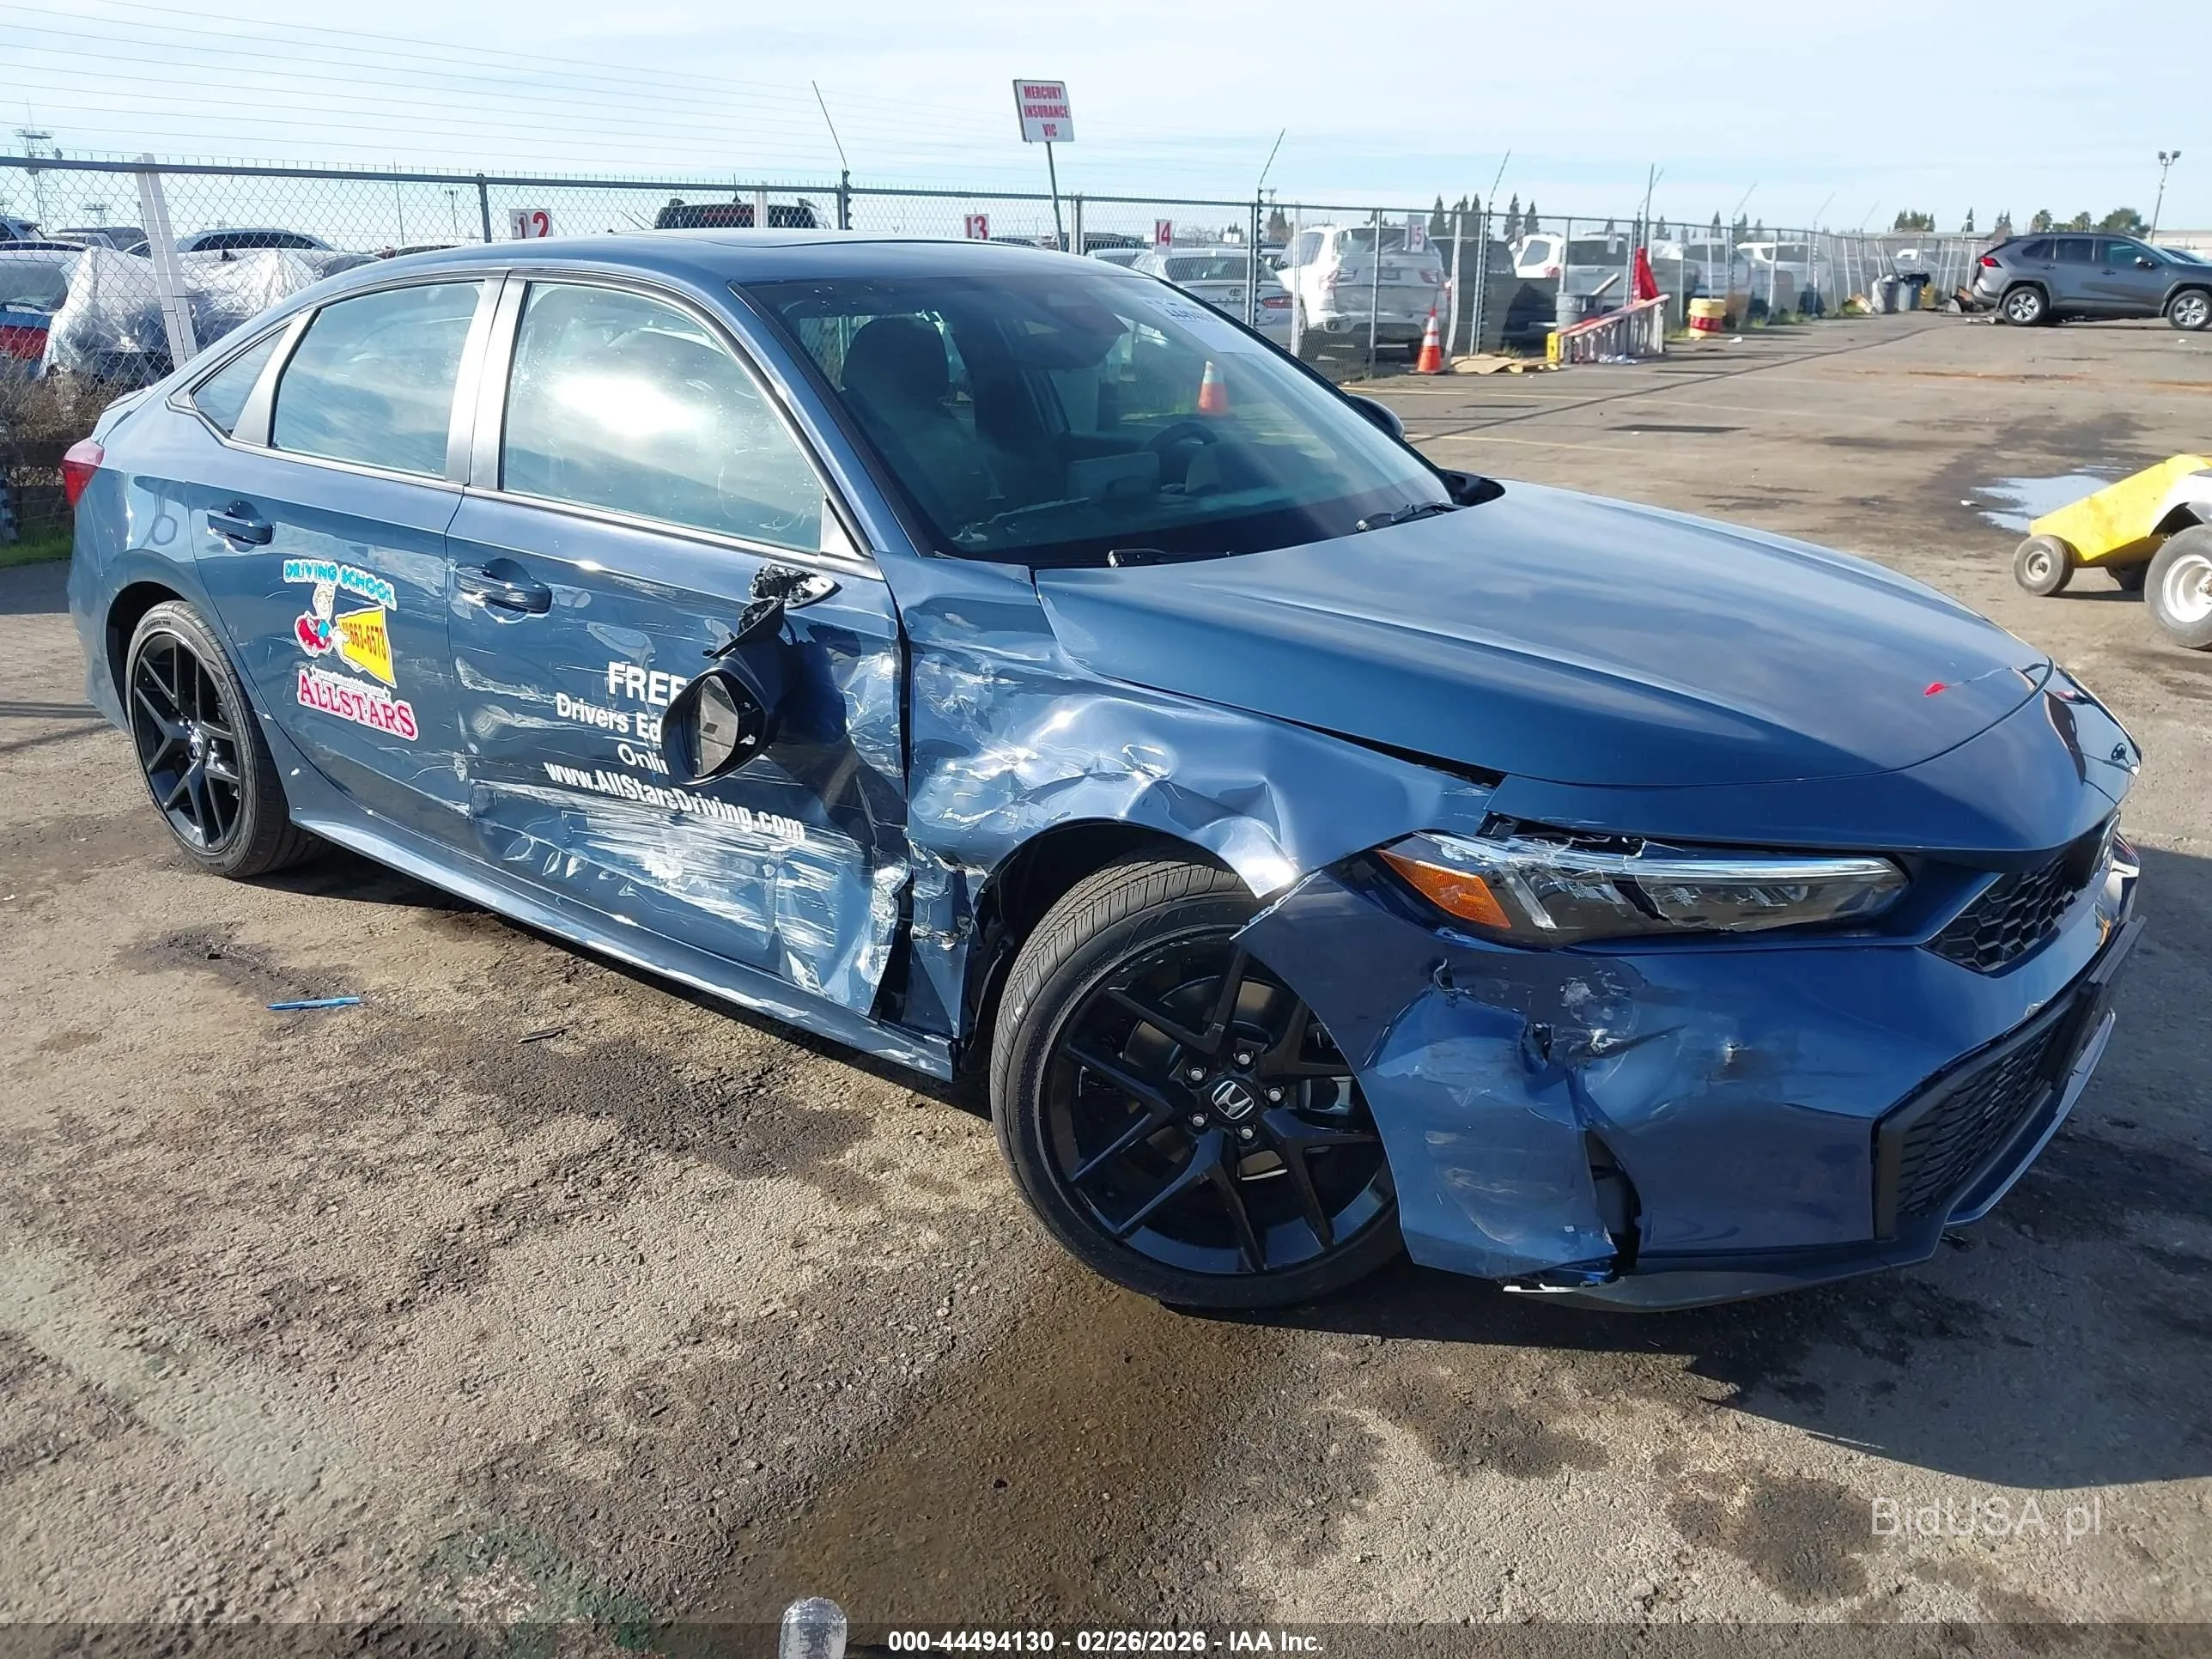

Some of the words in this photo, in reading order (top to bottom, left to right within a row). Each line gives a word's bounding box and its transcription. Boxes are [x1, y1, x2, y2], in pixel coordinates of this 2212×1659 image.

[1024, 86, 1062, 100] MERCURY
[1024, 105, 1070, 118] INSURANCE
[1042, 124, 1058, 137] VIC
[518, 211, 550, 239] 12
[965, 216, 988, 240] 13
[1156, 222, 1171, 246] 14
[285, 562, 337, 582] DRIVING
[341, 568, 395, 605] SCHOOL
[608, 660, 688, 707] FREE
[299, 674, 416, 737] ALLSTARS
[556, 691, 629, 733] Drivers
[543, 762, 805, 841] www.AllStarsDriving.com
